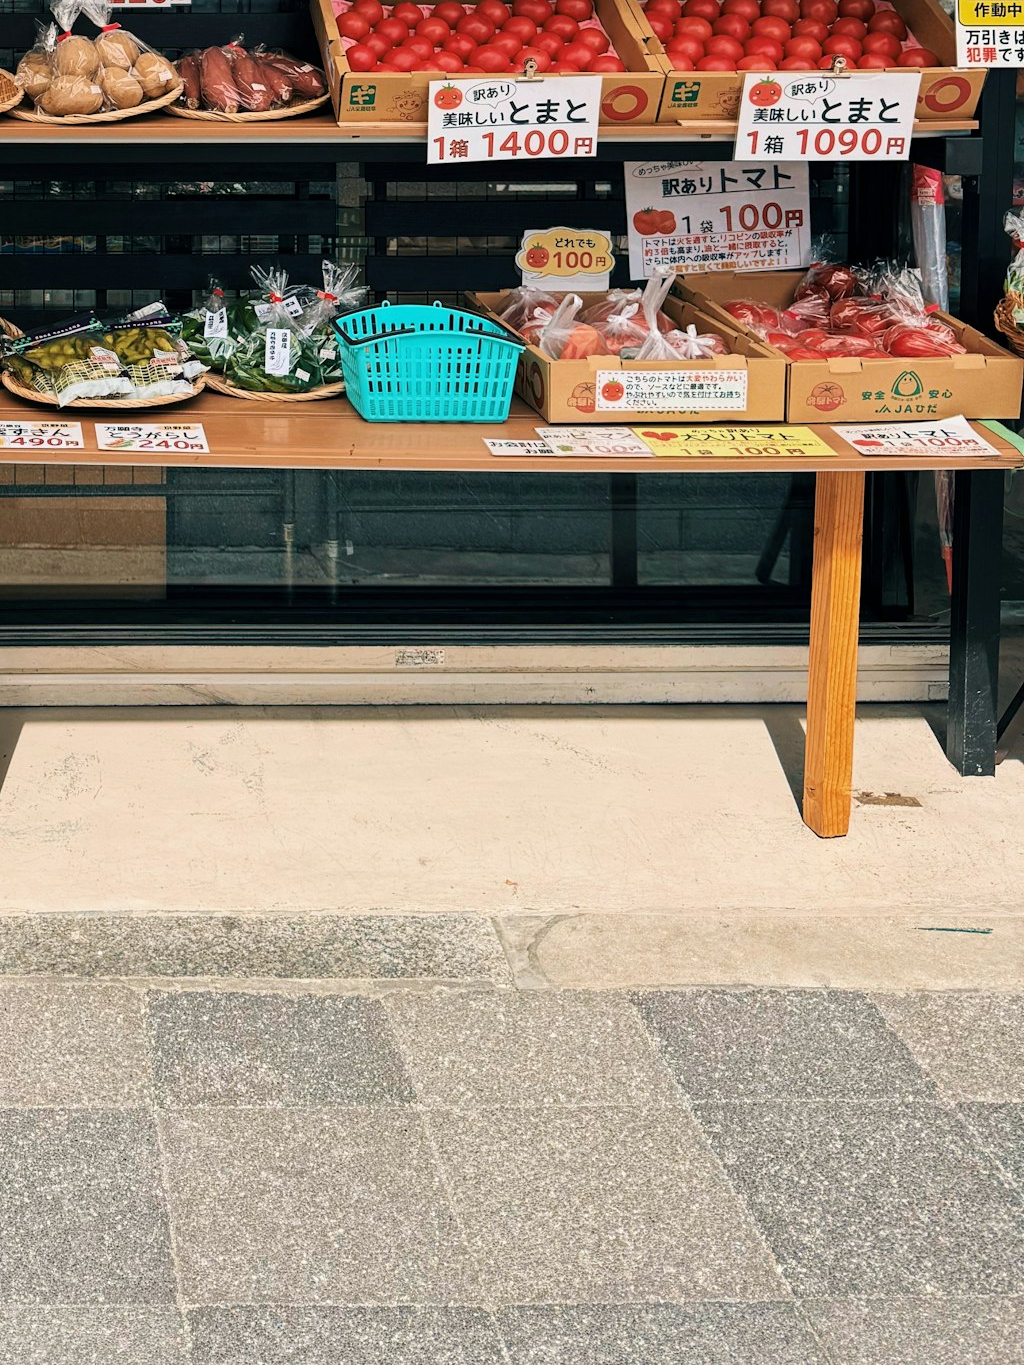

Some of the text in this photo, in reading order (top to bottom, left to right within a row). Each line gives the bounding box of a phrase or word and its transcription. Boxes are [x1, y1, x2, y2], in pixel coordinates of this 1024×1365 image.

[974, 2, 1022, 18] 作動中
[473, 84, 511, 102] 訳あり
[791, 80, 829, 97] 訳あり
[442, 99, 587, 127] 美味しいとまと
[753, 97, 900, 123] 美味しいとまと
[433, 129, 593, 160] 1箱 1400円
[747, 128, 905, 155] 1箱 1090円
[662, 165, 792, 196] 訳ありトマト
[719, 202, 804, 232] 100円
[555, 238, 596, 248] どれでも
[553, 251, 606, 269] 100円
[861, 389, 953, 401] 安全 安心
[894, 404, 937, 414] JAひだ
[108, 431, 199, 440] とうがらし
[680, 432, 795, 441] 大入りトマト
[861, 428, 957, 440] 訳ありトマト
[10, 437, 79, 446] 490円
[138, 439, 204, 450] 240円
[913, 438, 979, 447] 100円
[729, 446, 806, 455] 100円
